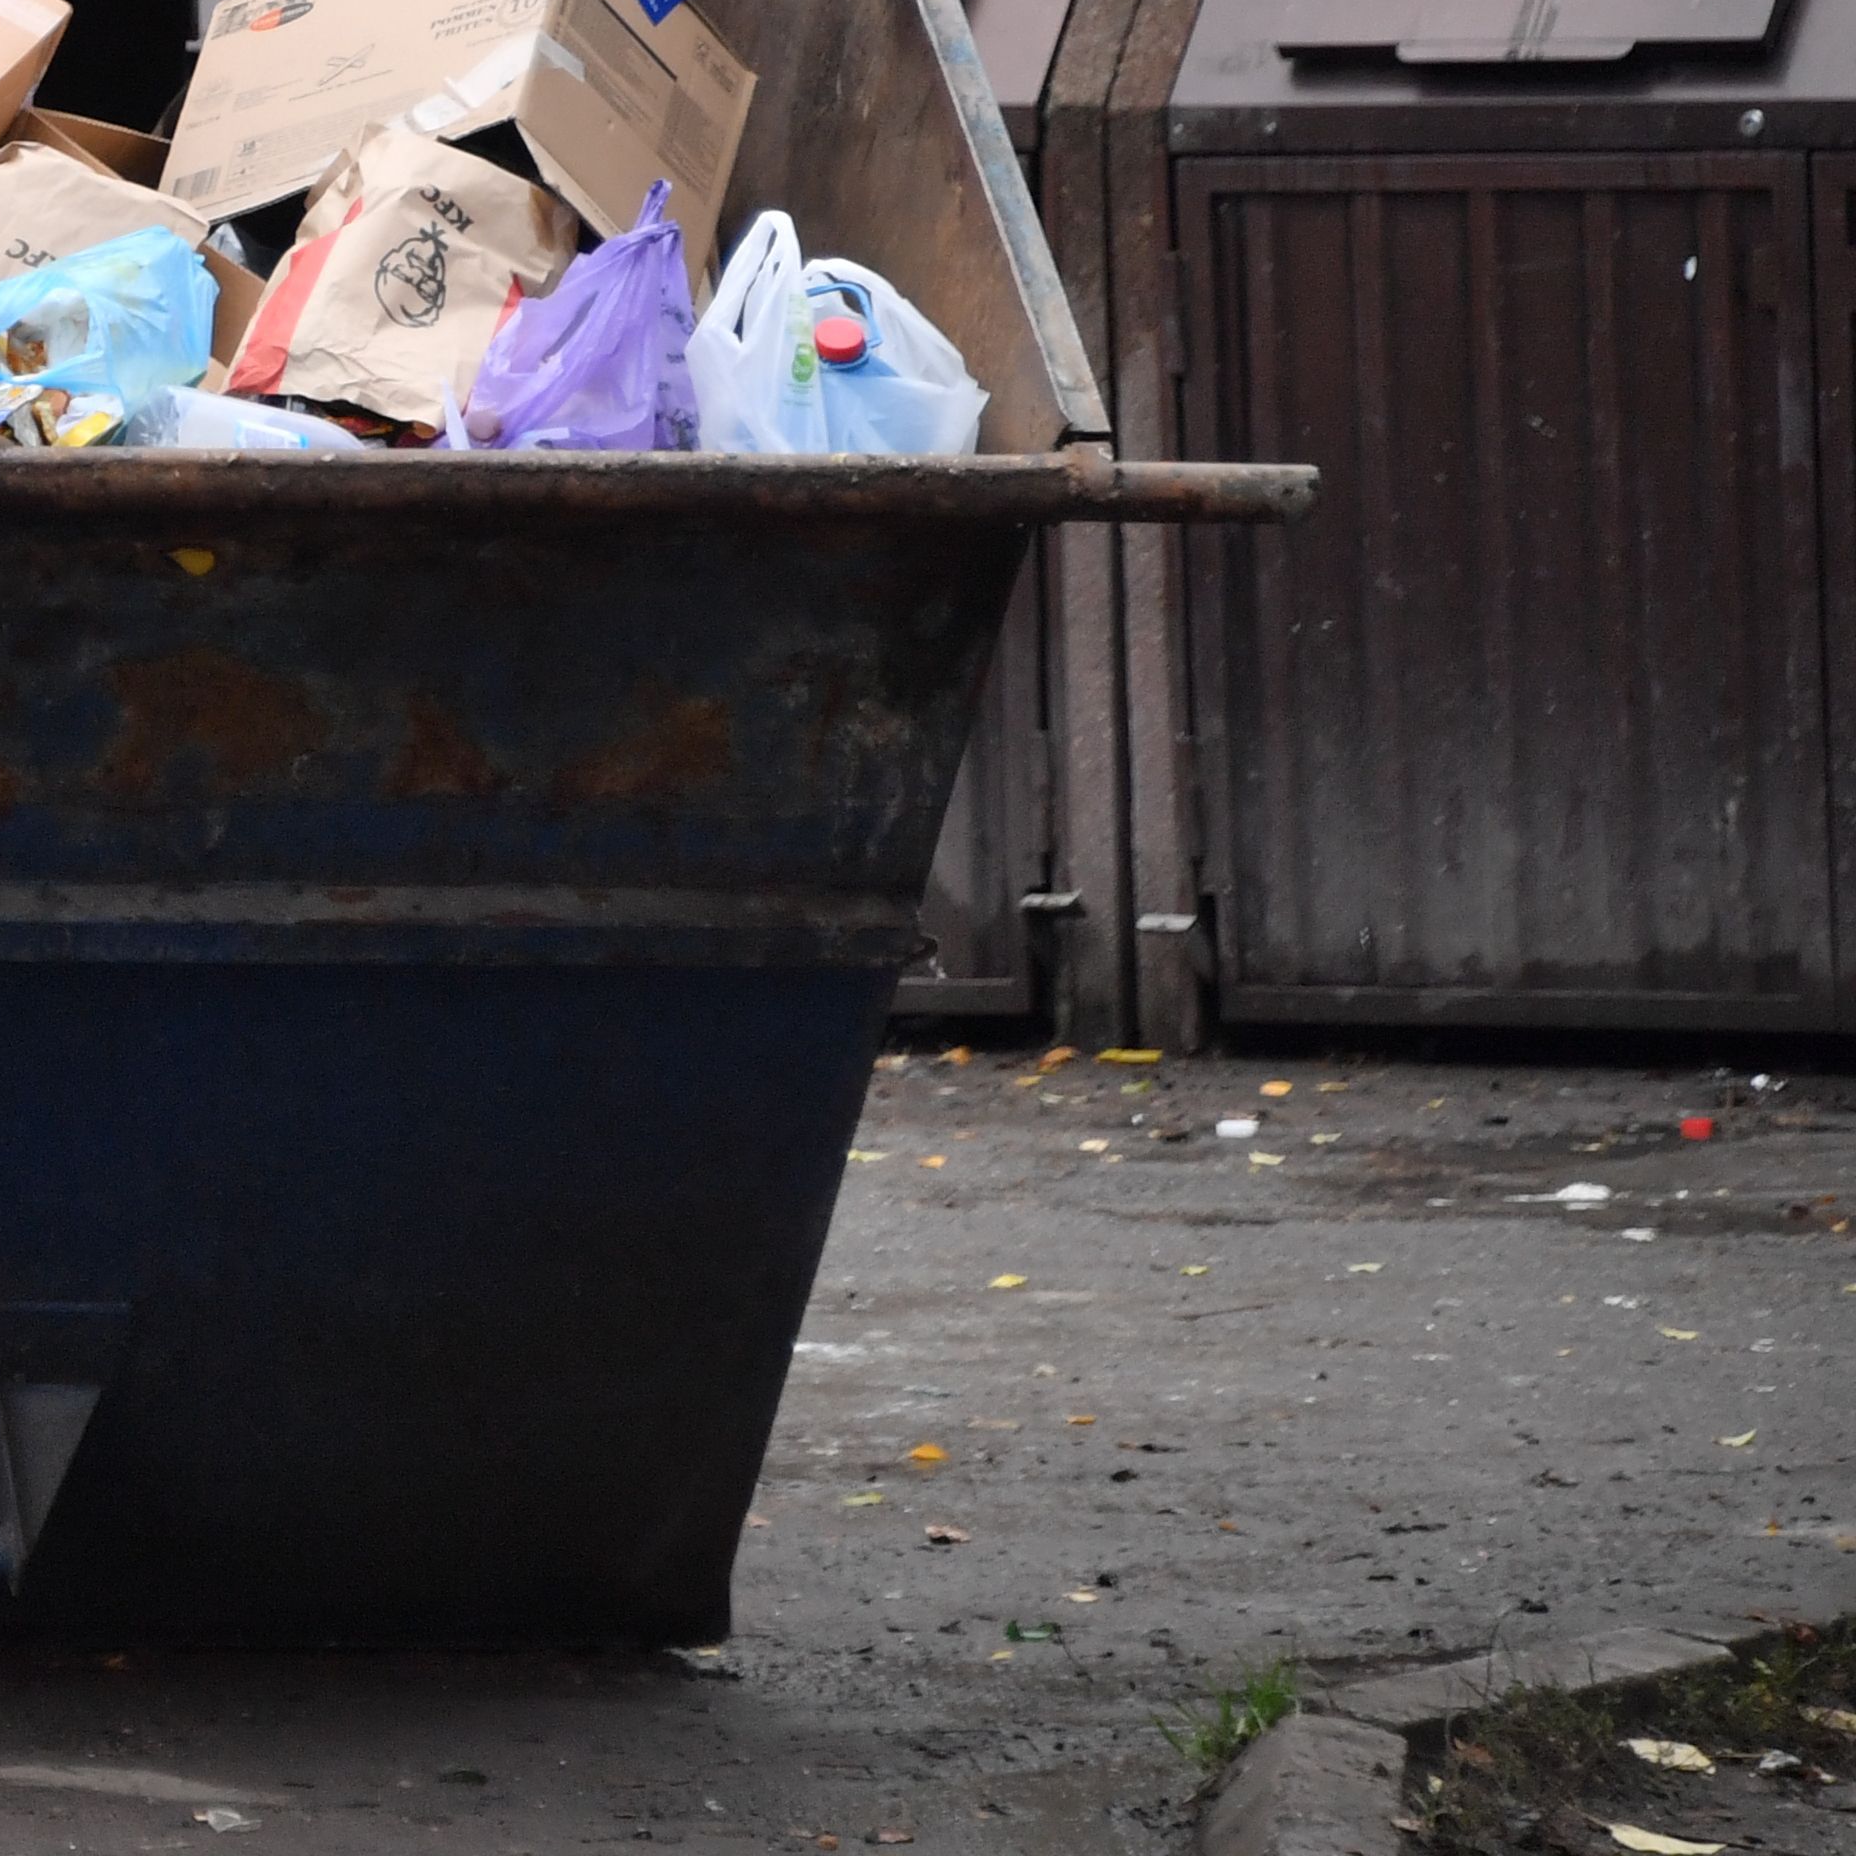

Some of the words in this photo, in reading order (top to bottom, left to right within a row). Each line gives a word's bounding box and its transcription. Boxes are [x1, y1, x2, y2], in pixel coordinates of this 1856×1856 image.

[433, 17, 494, 41] FRITES
[419, 184, 474, 233] KFC
[5, 238, 57, 268] FC
